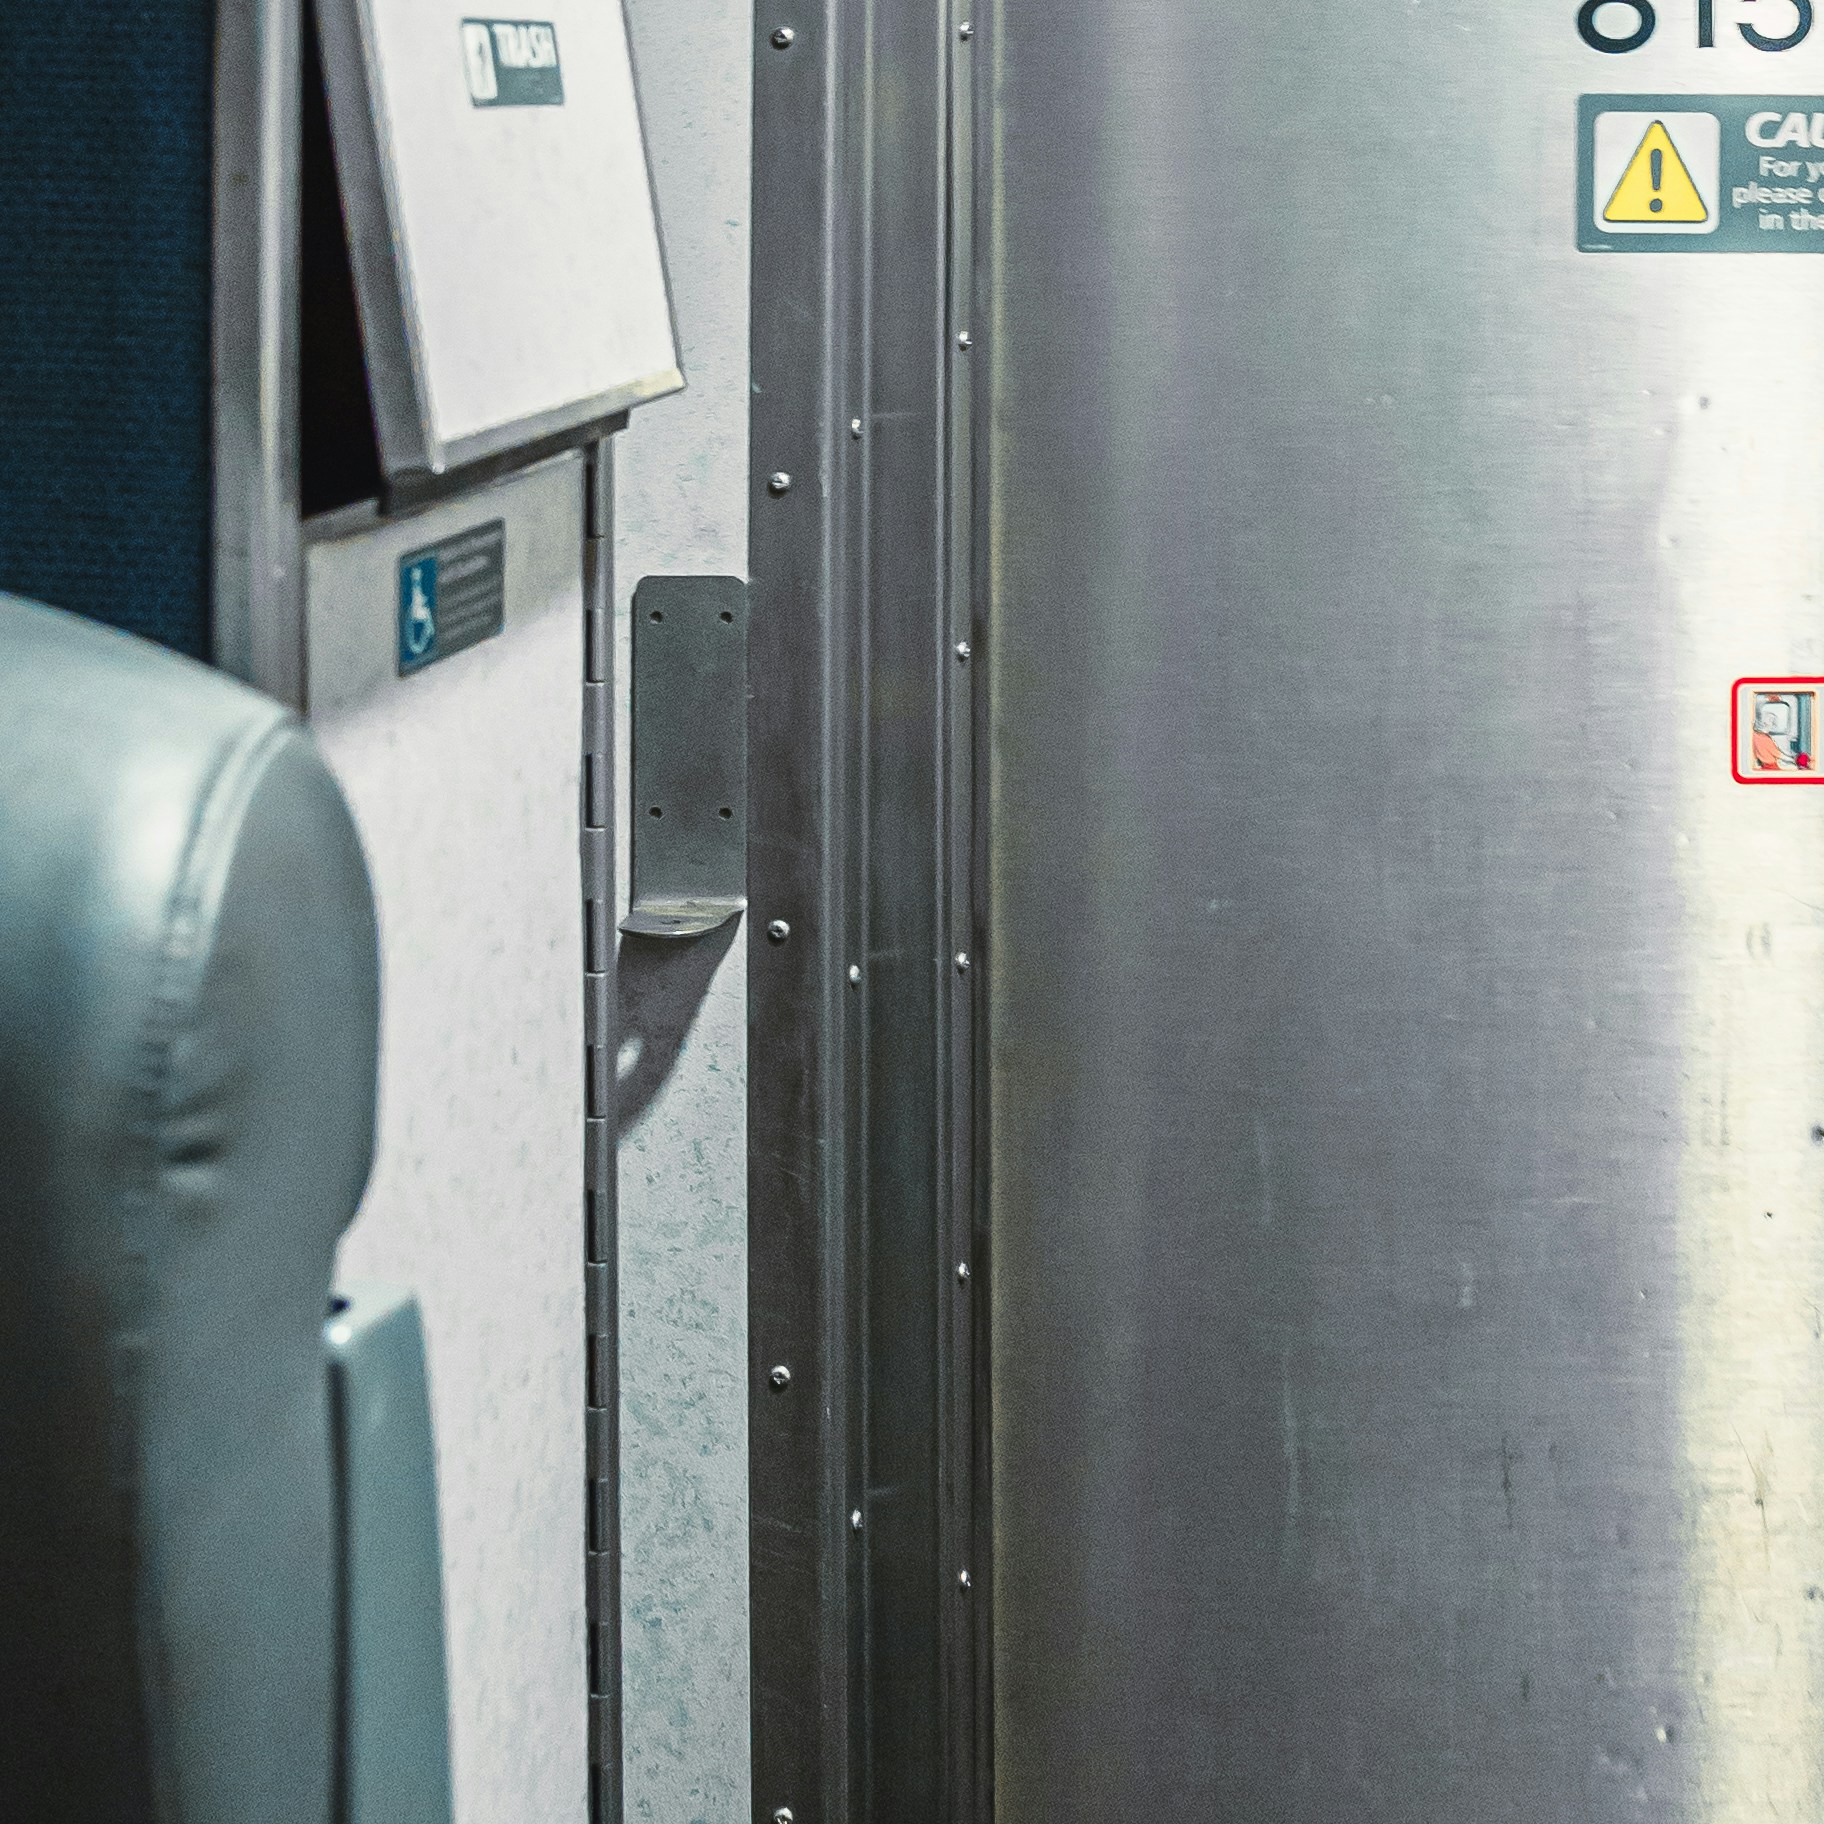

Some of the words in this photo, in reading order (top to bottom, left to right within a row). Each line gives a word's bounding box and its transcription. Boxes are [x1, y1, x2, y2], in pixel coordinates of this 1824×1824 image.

[1758, 155, 1801, 178] For
[1732, 180, 1814, 208] please
[1758, 208, 1785, 230] in
